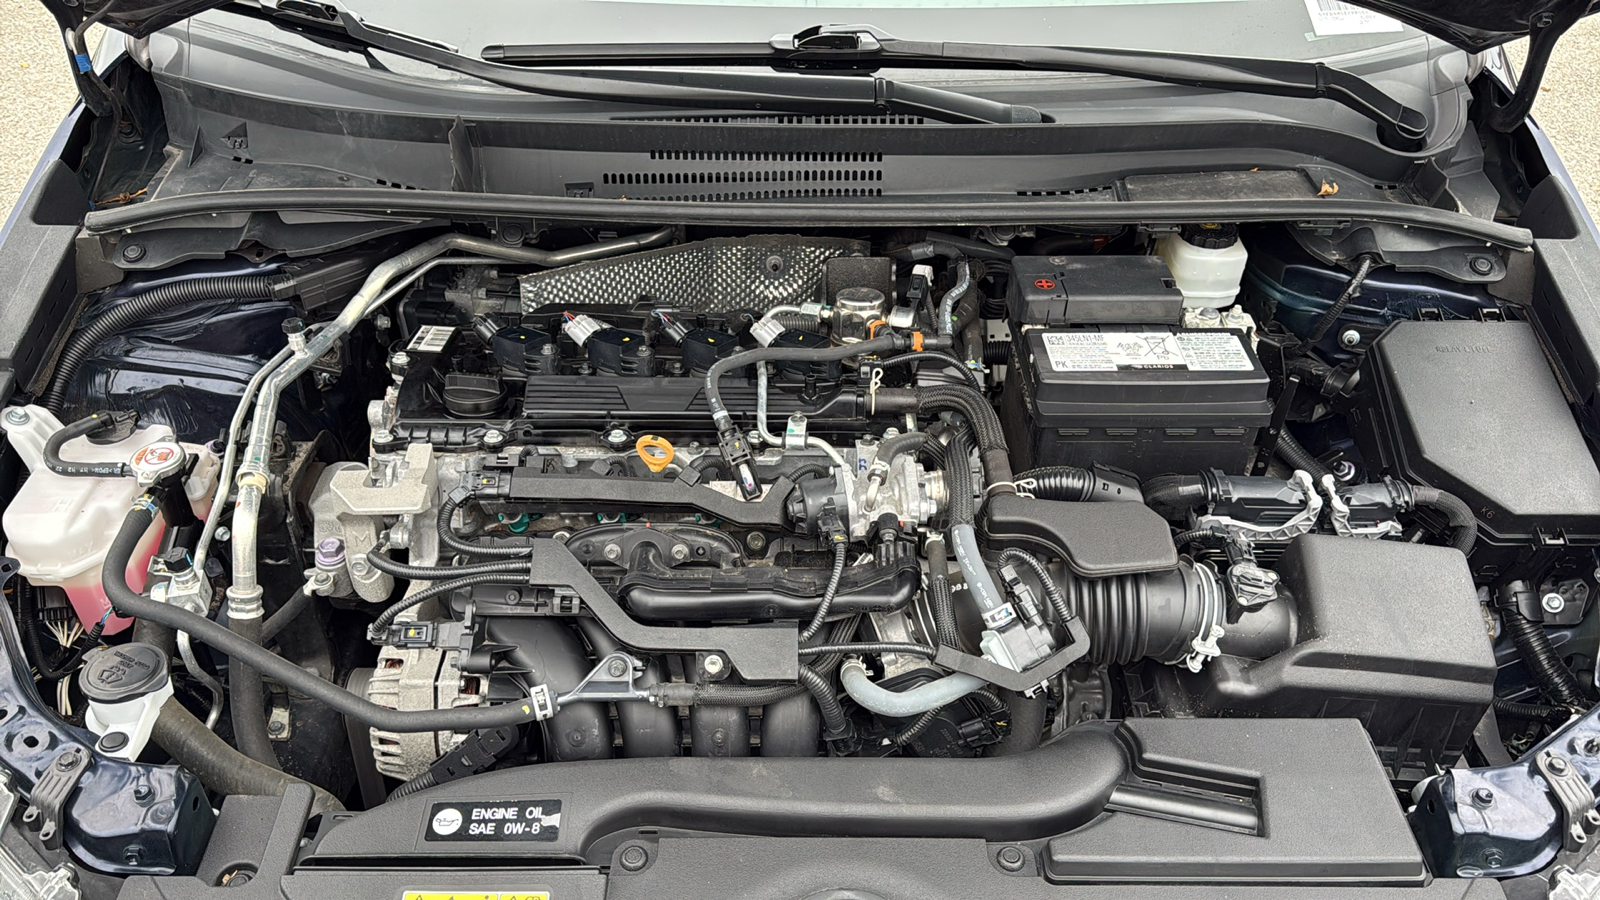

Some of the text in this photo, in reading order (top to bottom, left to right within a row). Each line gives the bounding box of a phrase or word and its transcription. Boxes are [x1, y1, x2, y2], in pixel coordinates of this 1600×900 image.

[1055, 360, 1069, 369] PK
[471, 806, 545, 820] ENGINE OIL
[469, 822, 540, 835] SAE 0W-8
